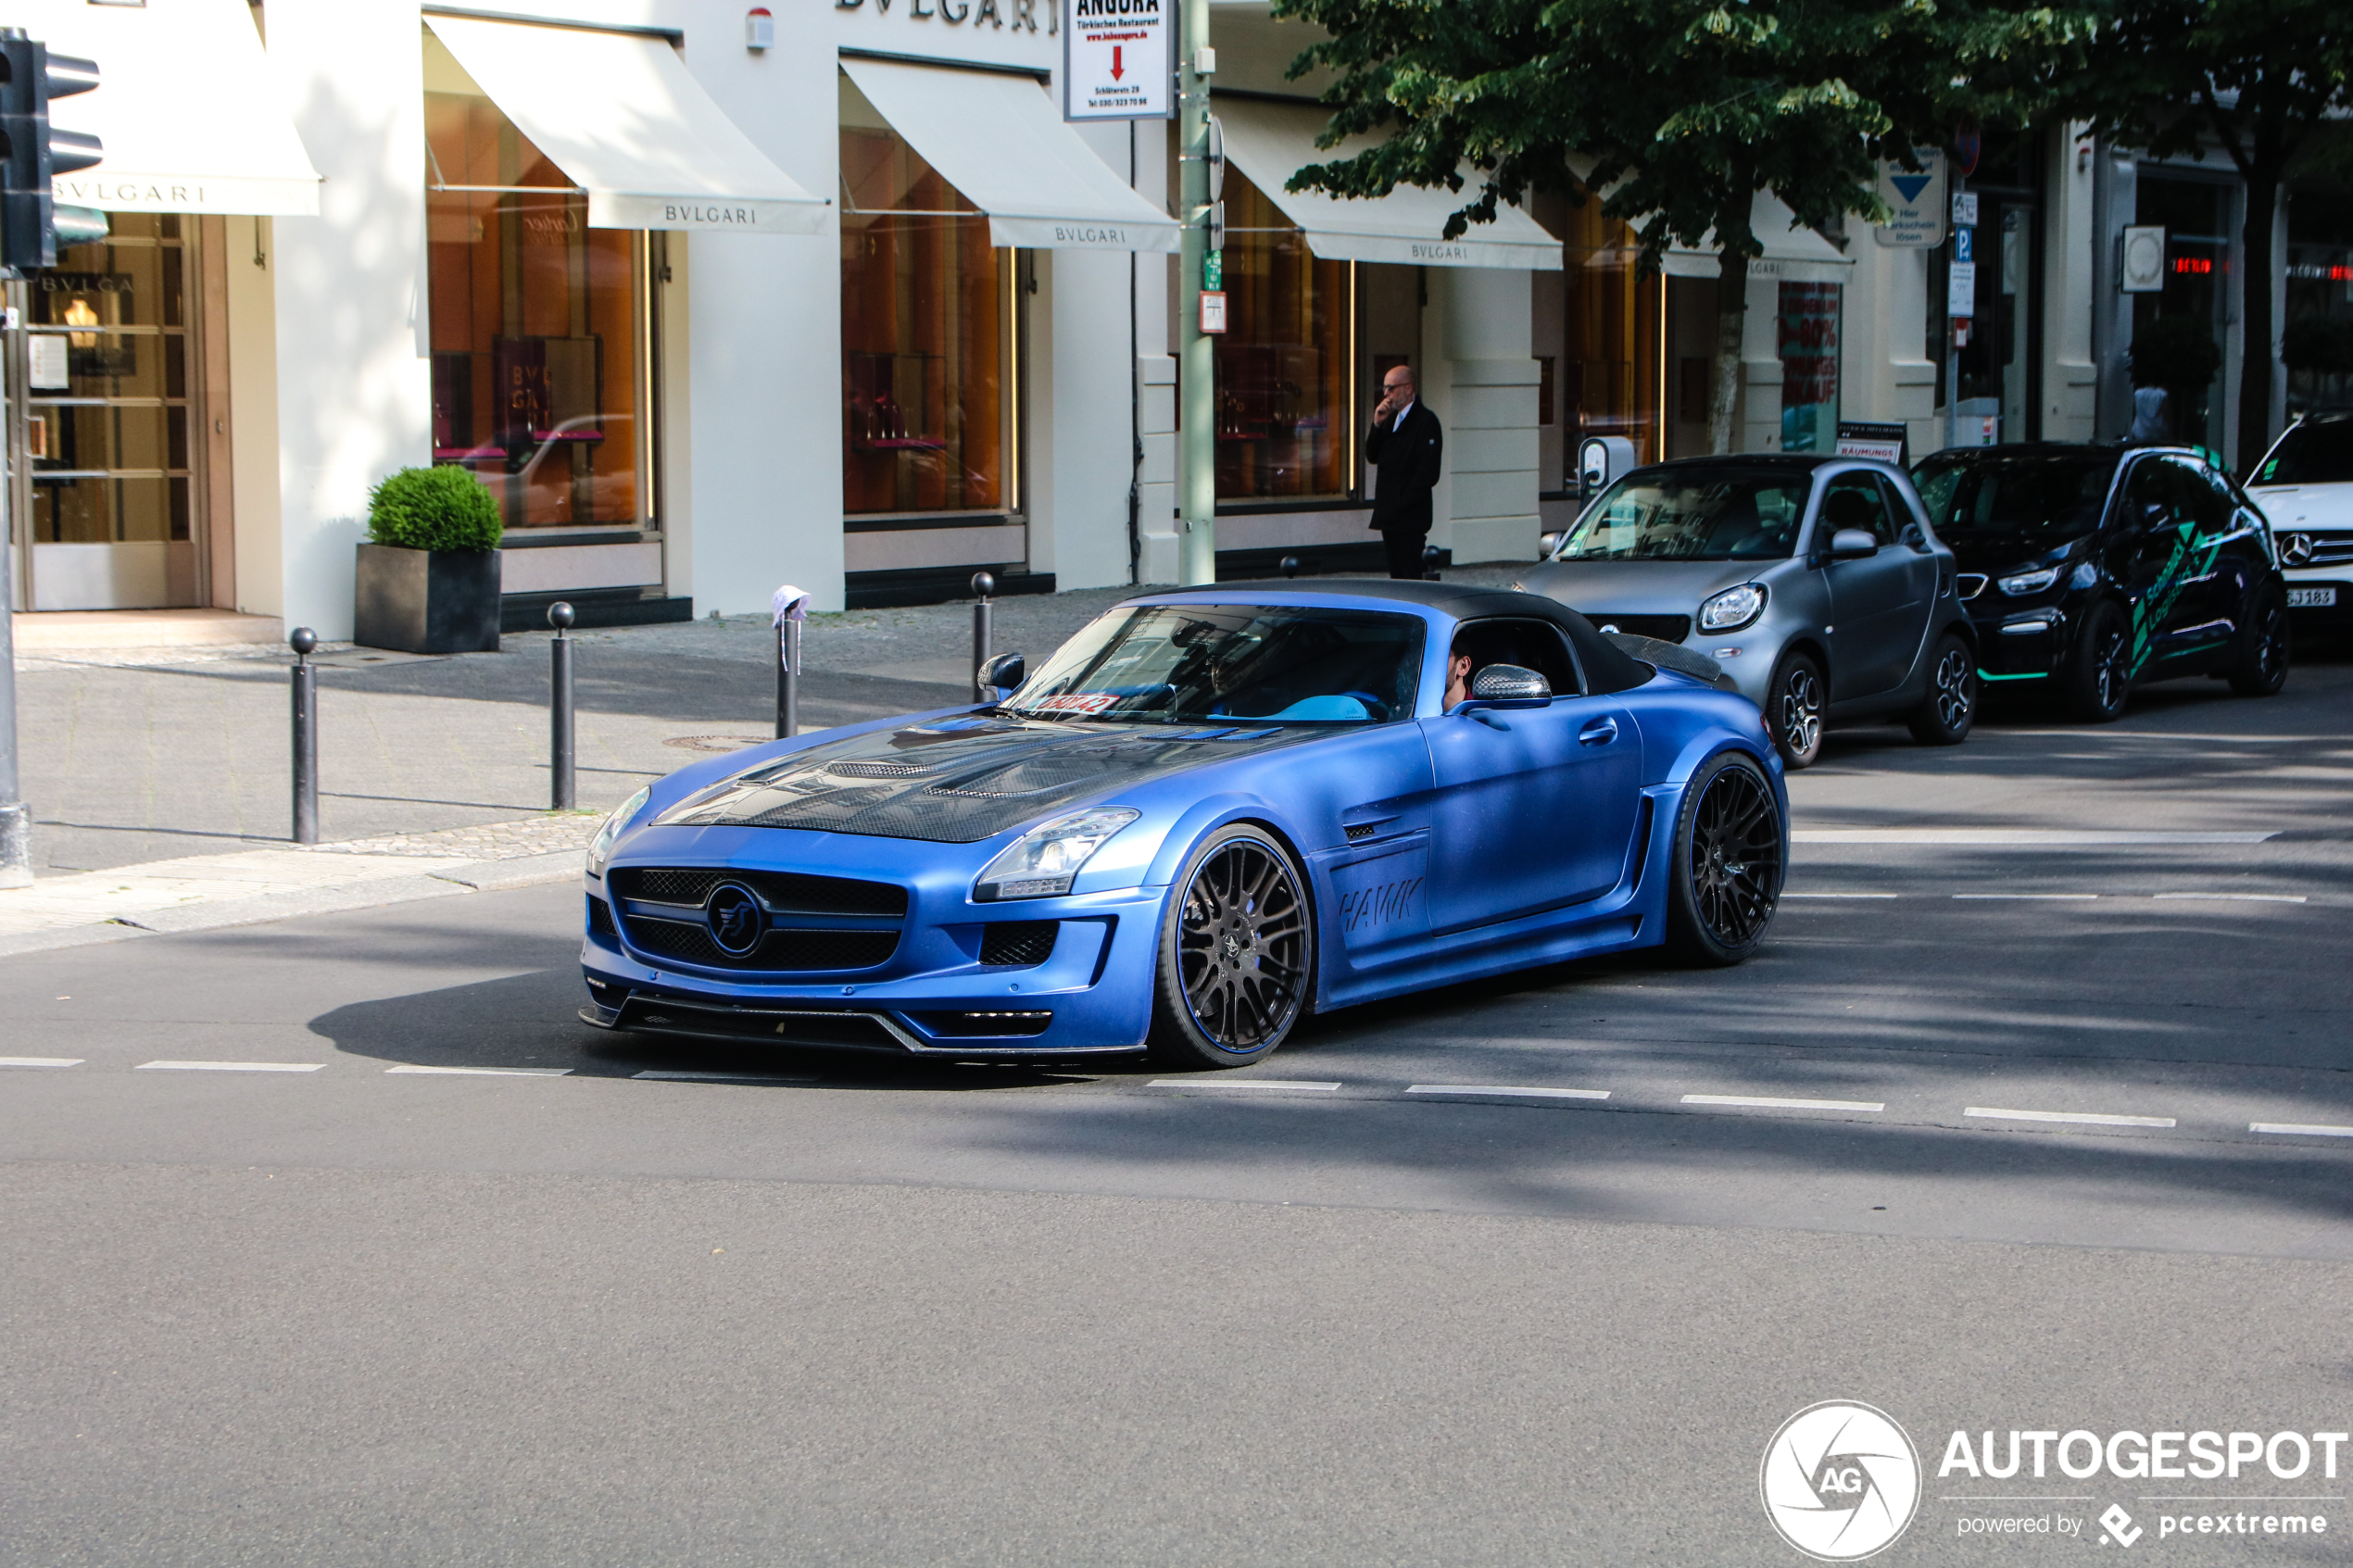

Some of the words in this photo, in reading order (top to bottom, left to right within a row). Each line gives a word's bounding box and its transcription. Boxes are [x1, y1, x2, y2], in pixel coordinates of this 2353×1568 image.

[1077, 0, 1159, 16] ANGORA
[1118, 18, 1159, 27] Restaurant
[52, 182, 205, 203] BVLGARI
[666, 206, 756, 224] BVLGARI
[1883, 221, 1935, 231] arkschein
[1055, 226, 1126, 244] BVLGARI
[1412, 245, 1467, 259] BVLGARI
[1749, 262, 1780, 274] LGARI
